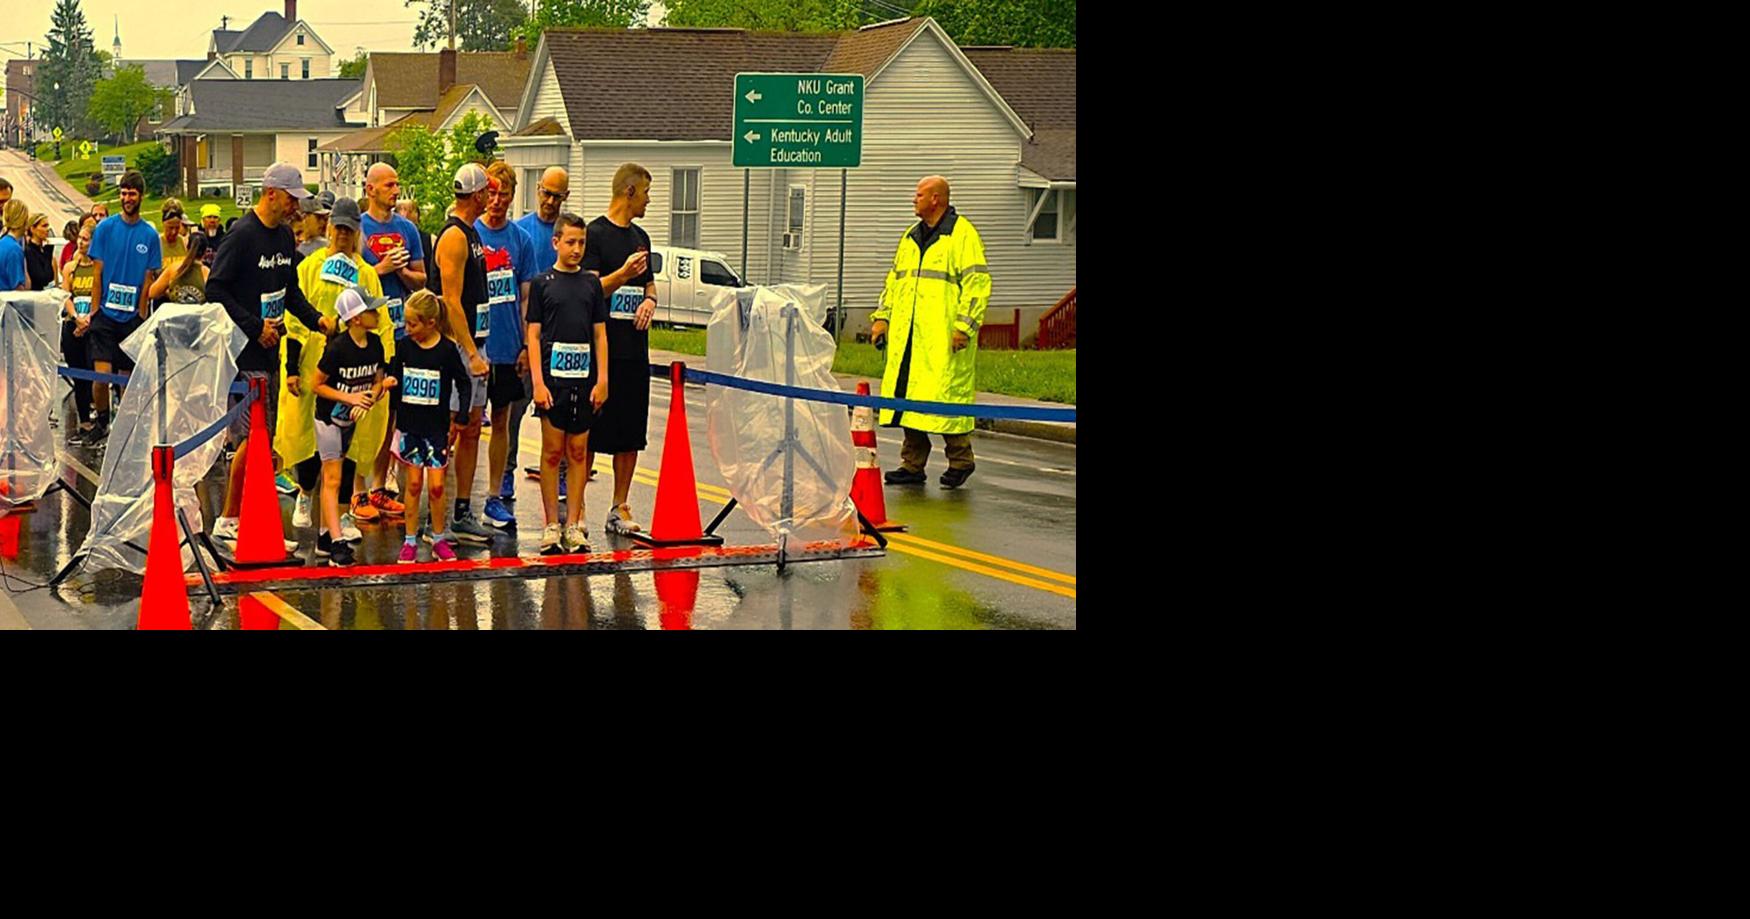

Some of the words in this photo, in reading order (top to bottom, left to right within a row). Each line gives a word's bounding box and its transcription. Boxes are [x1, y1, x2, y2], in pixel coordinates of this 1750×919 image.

[797, 80, 821, 95] NKU
[826, 80, 855, 95] Grant
[797, 100, 814, 114] Co.
[818, 100, 853, 115] Center
[771, 128, 820, 146] Kentucky
[825, 128, 853, 143] Adult
[770, 148, 822, 162] Education
[237, 196, 251, 206] 25
[325, 259, 356, 282] 2922
[488, 278, 512, 297] 924
[108, 289, 134, 306] 2914
[556, 351, 588, 371] 2882
[404, 376, 437, 398] 2996
